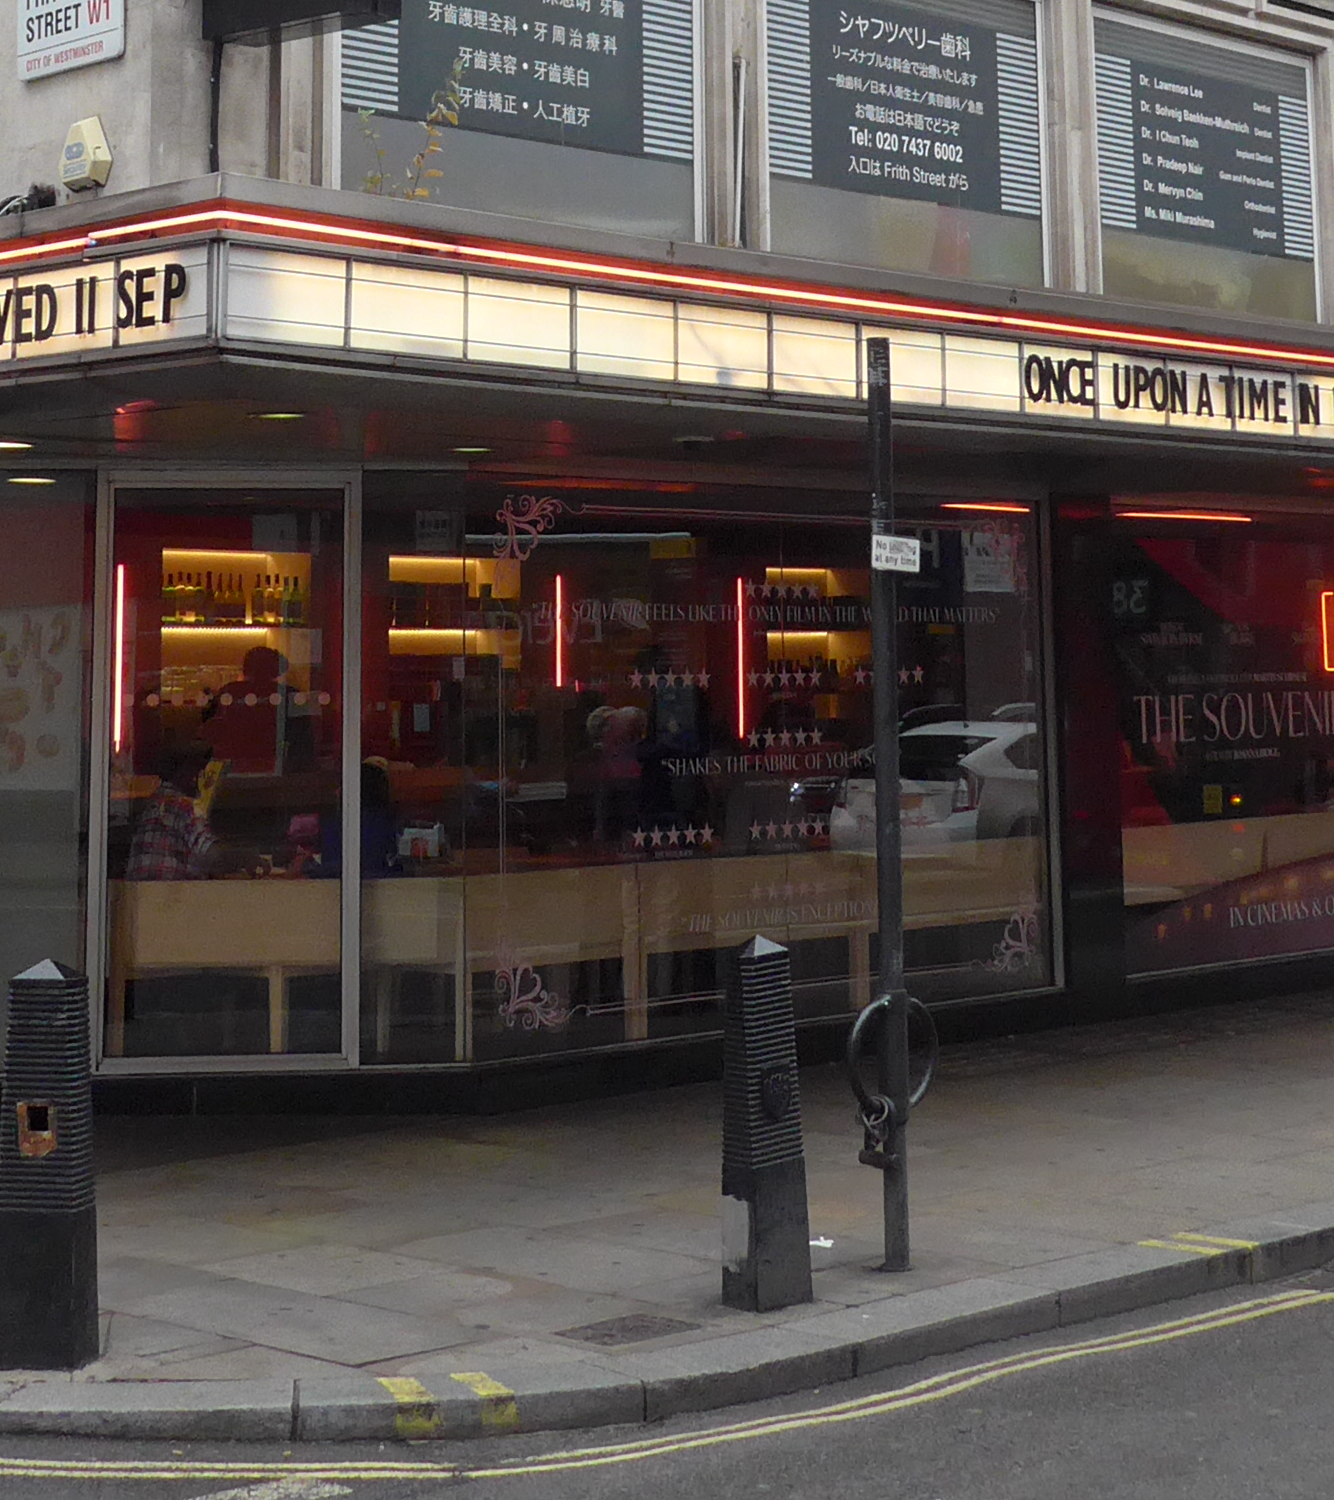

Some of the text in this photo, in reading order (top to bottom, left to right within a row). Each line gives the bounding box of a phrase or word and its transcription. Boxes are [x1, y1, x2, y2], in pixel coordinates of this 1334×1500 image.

[26, 3, 81, 42] STREET
[26, 41, 104, 72] CITY OF WESTMINSTER
[1139, 74, 1150, 87] Dr.
[1154, 78, 1188, 96] Lawrence
[1189, 85, 1203, 99] Lee
[1140, 101, 1151, 113] Dr.
[849, 126, 963, 163] Tel: 020 7437 6002
[1141, 126, 1152, 139] Dr.
[884, 161, 910, 181] Frith
[913, 167, 946, 188] Street
[1142, 153, 1153, 165] Dr.
[1157, 156, 1187, 174] Pradeep
[1143, 179, 1203, 201] Dr. Mervyn Chin
[1144, 206, 1157, 219] Ms.
[1159, 208, 1174, 222] Miki
[117, 263, 186, 329] SEP
[1025, 354, 1095, 406] ONCE
[1113, 362, 1188, 415] UPON
[1196, 373, 1214, 417] A
[1219, 375, 1288, 424] TIME
[1298, 382, 1320, 426] IN
[876, 541, 887, 551] No
[875, 553, 916, 566] at any time
[647, 603, 685, 621] FEELS
[688, 604, 717, 621] LIKE
[748, 606, 782, 623] ONLY
[787, 606, 816, 622] FILM
[818, 606, 831, 622] IN
[833, 606, 857, 622] THE
[912, 606, 940, 622] THAT
[1134, 694, 1196, 744] THE
[727, 756, 749, 774] THE
[755, 753, 801, 772] FABRIC
[804, 752, 823, 770] OF
[827, 751, 862, 769] YOUR
[1229, 906, 1245, 928] IN
[1247, 900, 1308, 926] CINEMAS
[1311, 899, 1324, 917] &
